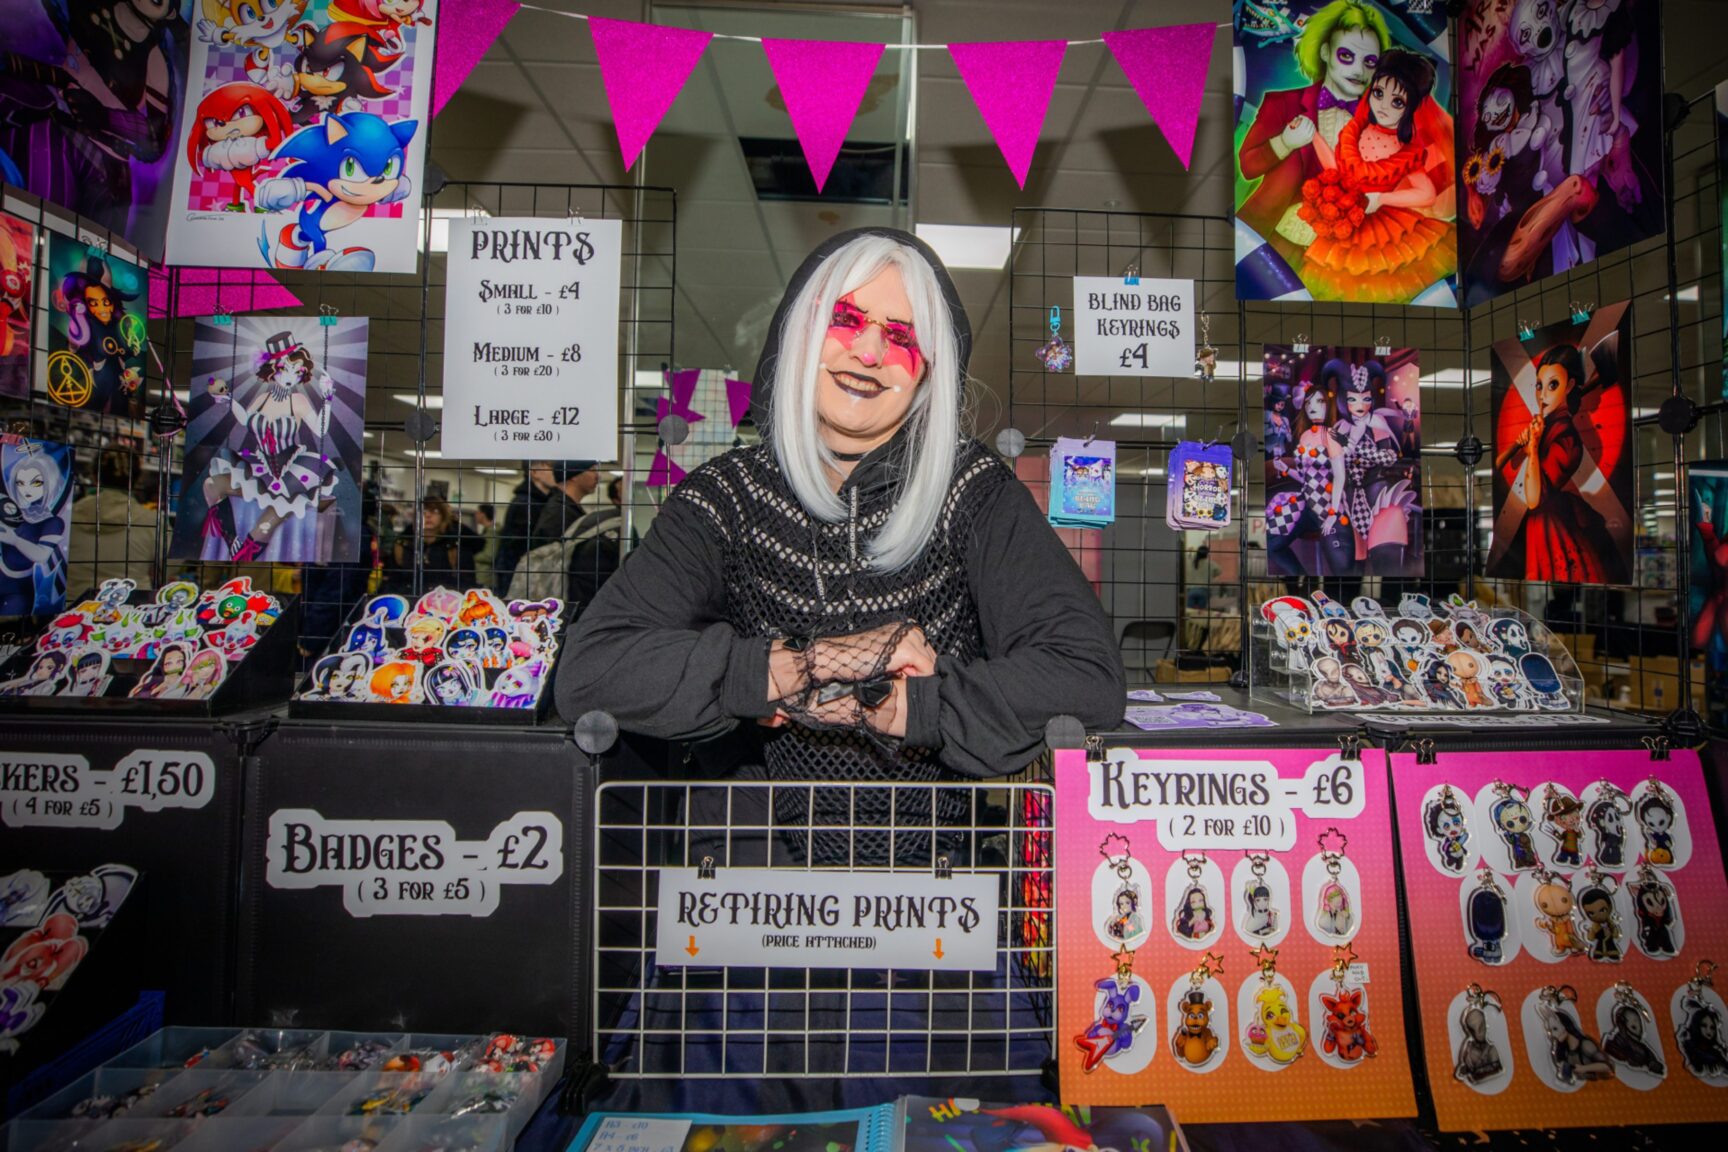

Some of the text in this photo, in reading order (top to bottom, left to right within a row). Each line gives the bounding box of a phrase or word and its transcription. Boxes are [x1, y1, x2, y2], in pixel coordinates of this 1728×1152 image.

[470, 229, 595, 265] PRINTS
[478, 279, 538, 303] SMALL
[559, 281, 580, 300] £4
[515, 304, 533, 316] FOR
[535, 304, 553, 316] £10
[1088, 292, 1182, 313] BLIND BAG
[1097, 318, 1181, 340] KEYRINGS
[473, 342, 540, 363] MEDIUM
[561, 343, 582, 363] £8
[1119, 342, 1149, 369] £4
[512, 366, 531, 378] FOR
[533, 364, 553, 378] £20
[473, 405, 531, 427] LARGE
[551, 406, 580, 426] £12
[512, 431, 531, 442] FOR
[533, 429, 554, 442] £30
[0, 762, 80, 794] KERS
[1100, 760, 1270, 810] KEYRINGS
[1312, 765, 1353, 806] £6
[44, 799, 73, 816] FOR
[79, 798, 101, 817] £5
[1183, 814, 1196, 836] 2
[1203, 818, 1235, 837] FOR
[1242, 814, 1272, 837] £10
[280, 822, 445, 875] BADGES
[497, 825, 549, 870] £2
[372, 877, 389, 901] 3
[398, 881, 435, 901] FOR
[443, 877, 470, 900] £5
[677, 891, 980, 934] RETIRING PRINTS
[761, 934, 877, 949] (PRICE ATTACHED)
